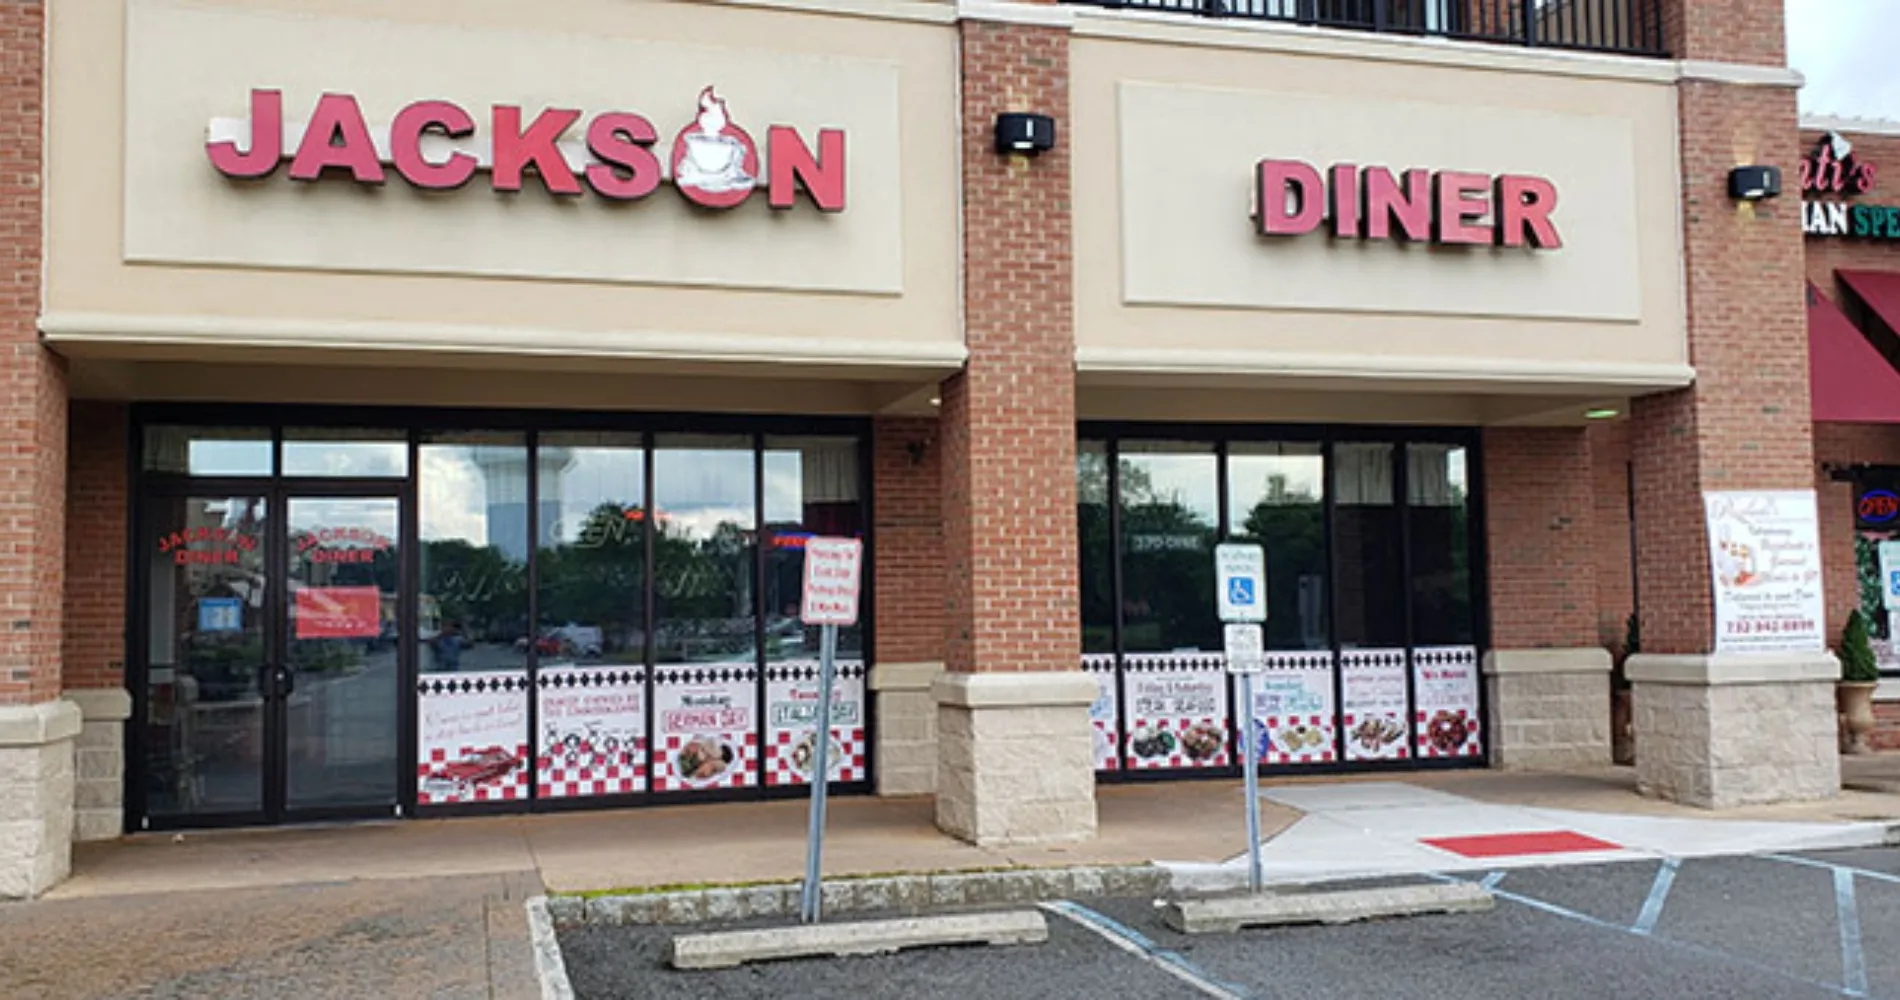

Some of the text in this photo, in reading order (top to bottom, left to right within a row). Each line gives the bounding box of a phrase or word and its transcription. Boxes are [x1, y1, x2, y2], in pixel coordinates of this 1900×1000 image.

[205, 85, 846, 212] JACKSON
[1257, 159, 1563, 249] DINER
[159, 526, 258, 552] JACKSON
[298, 526, 390, 552] JACKSON
[174, 550, 240, 566] DINER
[312, 549, 374, 564] DINER
